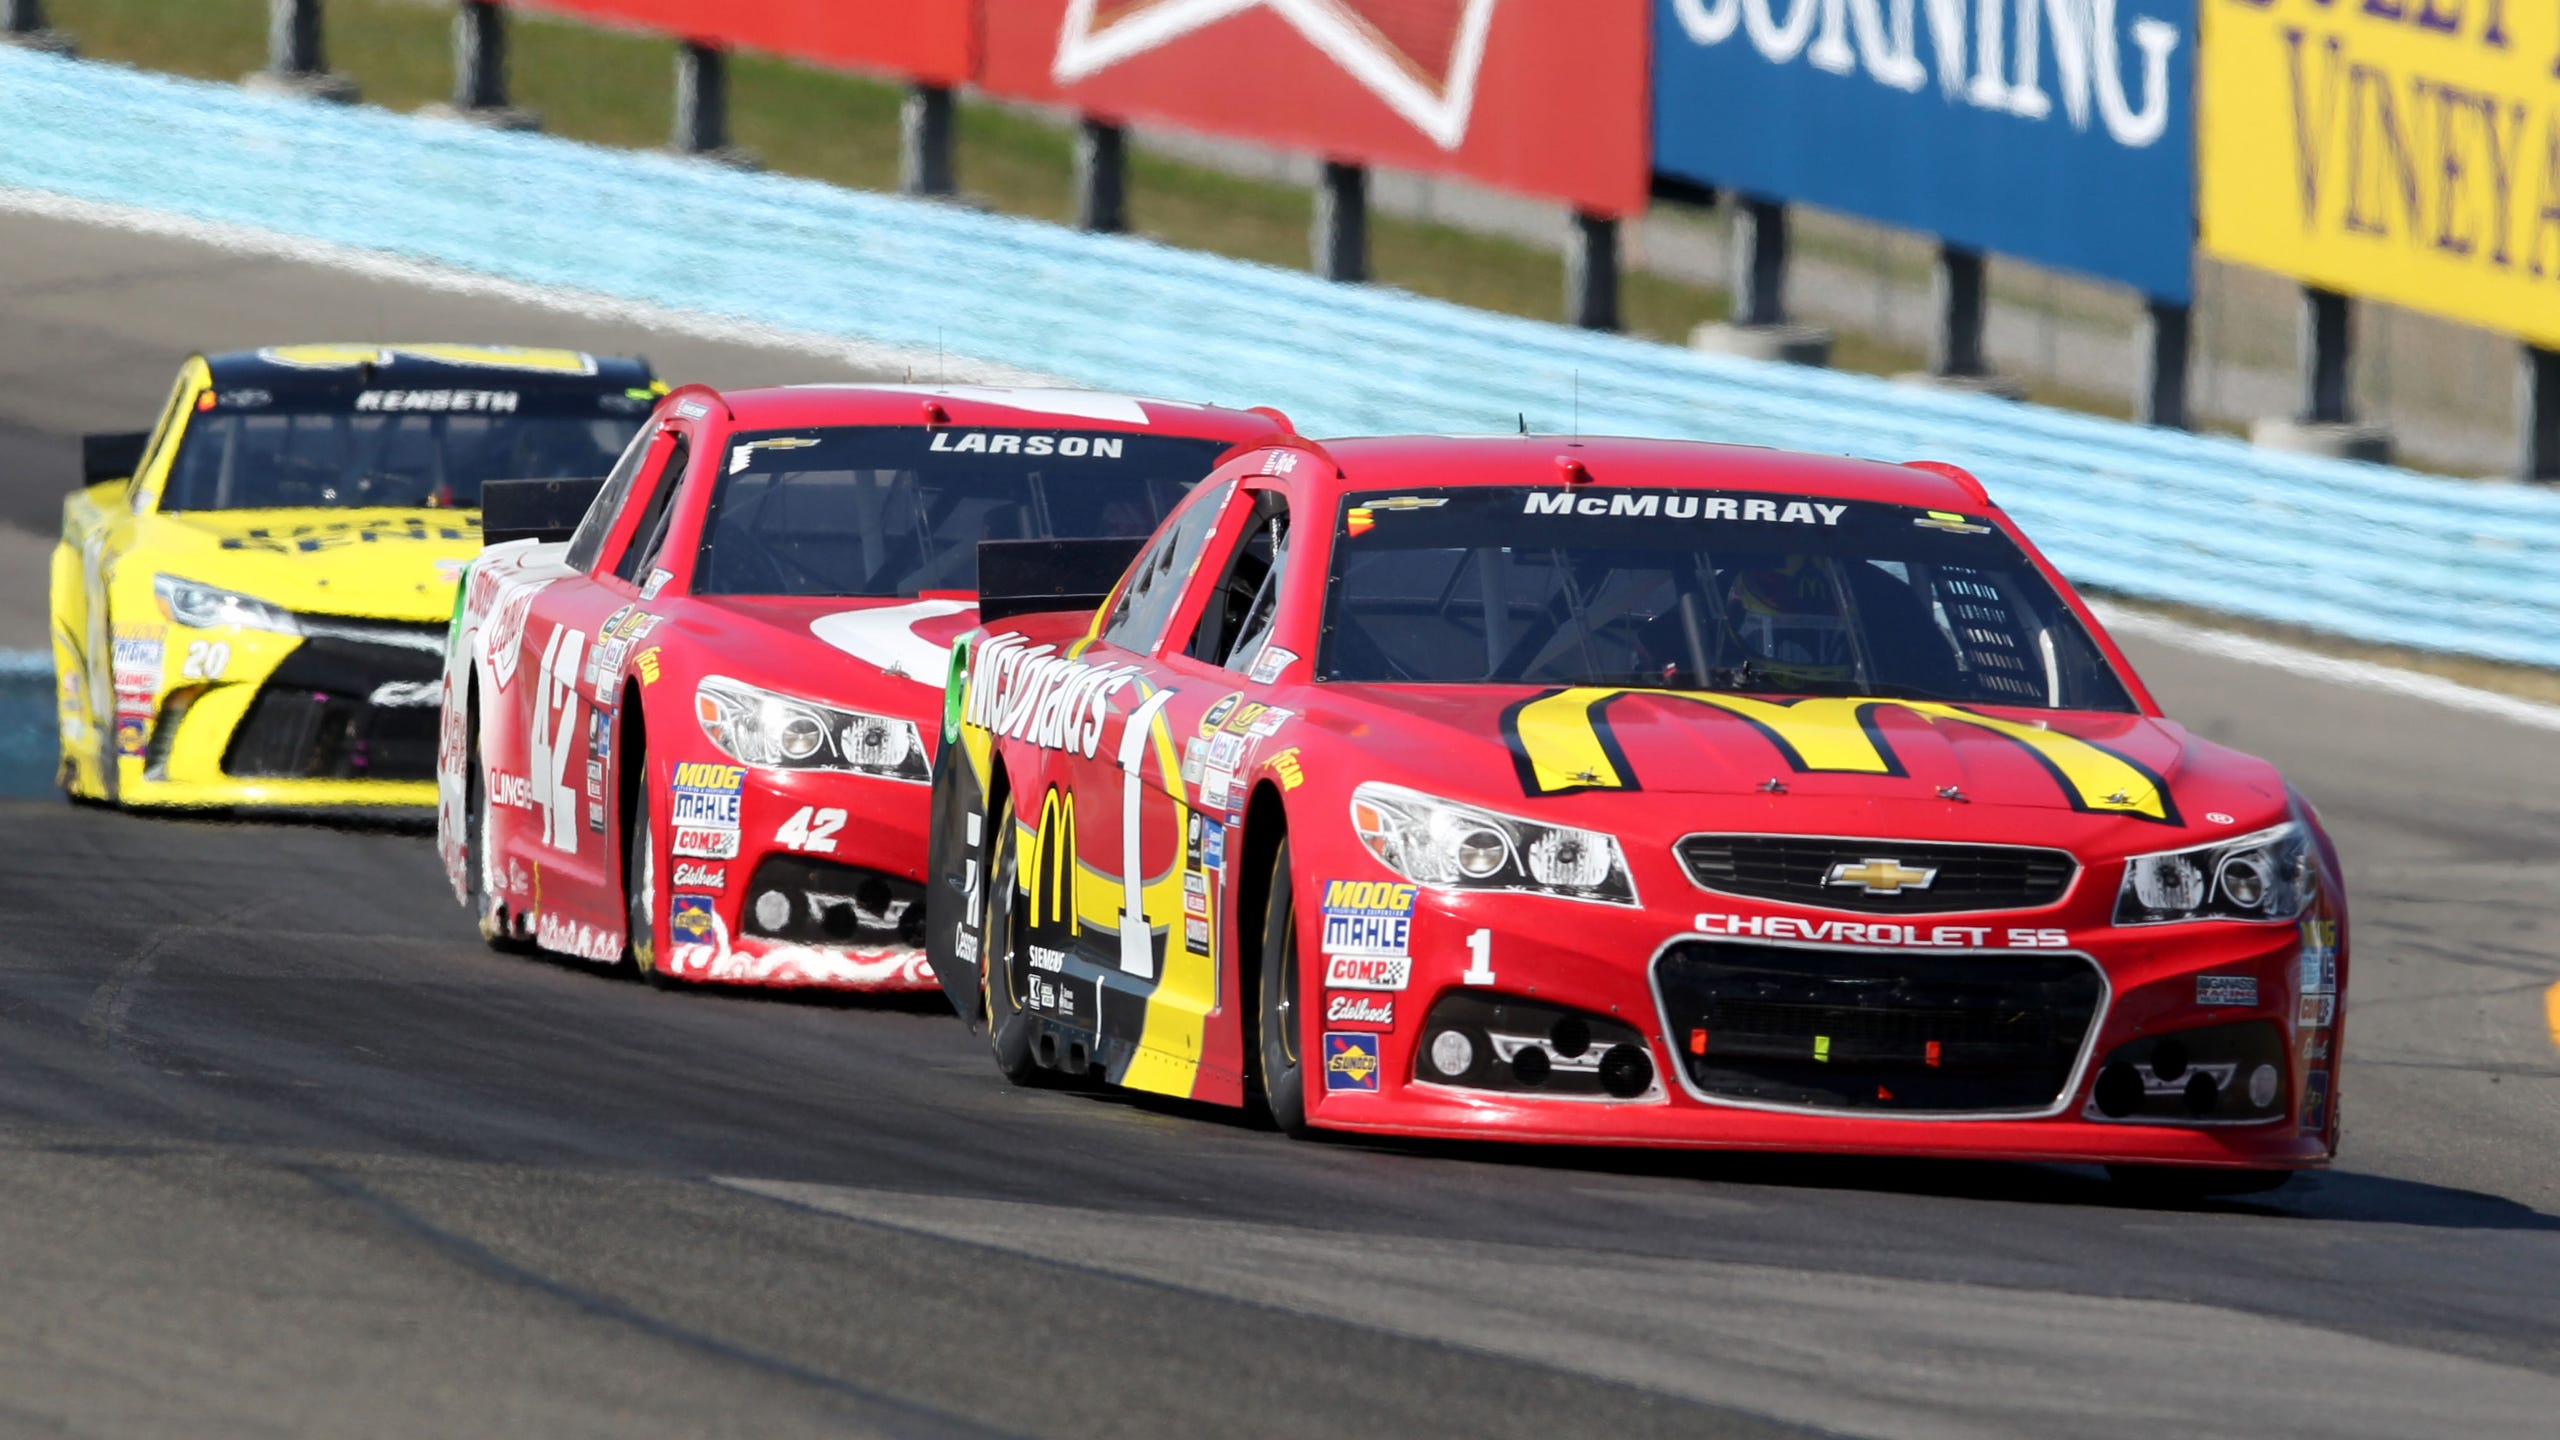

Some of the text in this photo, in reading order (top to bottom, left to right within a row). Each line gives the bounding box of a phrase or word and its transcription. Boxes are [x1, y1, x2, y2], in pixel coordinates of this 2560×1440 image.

[356, 389, 520, 413] KENSETH
[930, 431, 1124, 459] LARSON
[1522, 491, 1848, 527] McMURRAY
[183, 639, 231, 680] 20
[531, 622, 586, 854] 42
[674, 762, 746, 788] MOOG
[676, 793, 737, 822] MAHLE
[679, 831, 722, 850] COMP
[774, 806, 848, 853] 42
[1324, 880, 1418, 911] MOOG
[1327, 917, 1408, 948] MAHLE
[1694, 912, 2070, 947] CHEVROLET SS
[1029, 944, 1066, 973] SIEMENS
[1333, 960, 1387, 980] COMP
[1463, 928, 1496, 985] 1
[2198, 988, 2257, 998] RACING
[1327, 996, 1393, 1024] Edelbrock
[1332, 1056, 1376, 1071] SUNOCO
